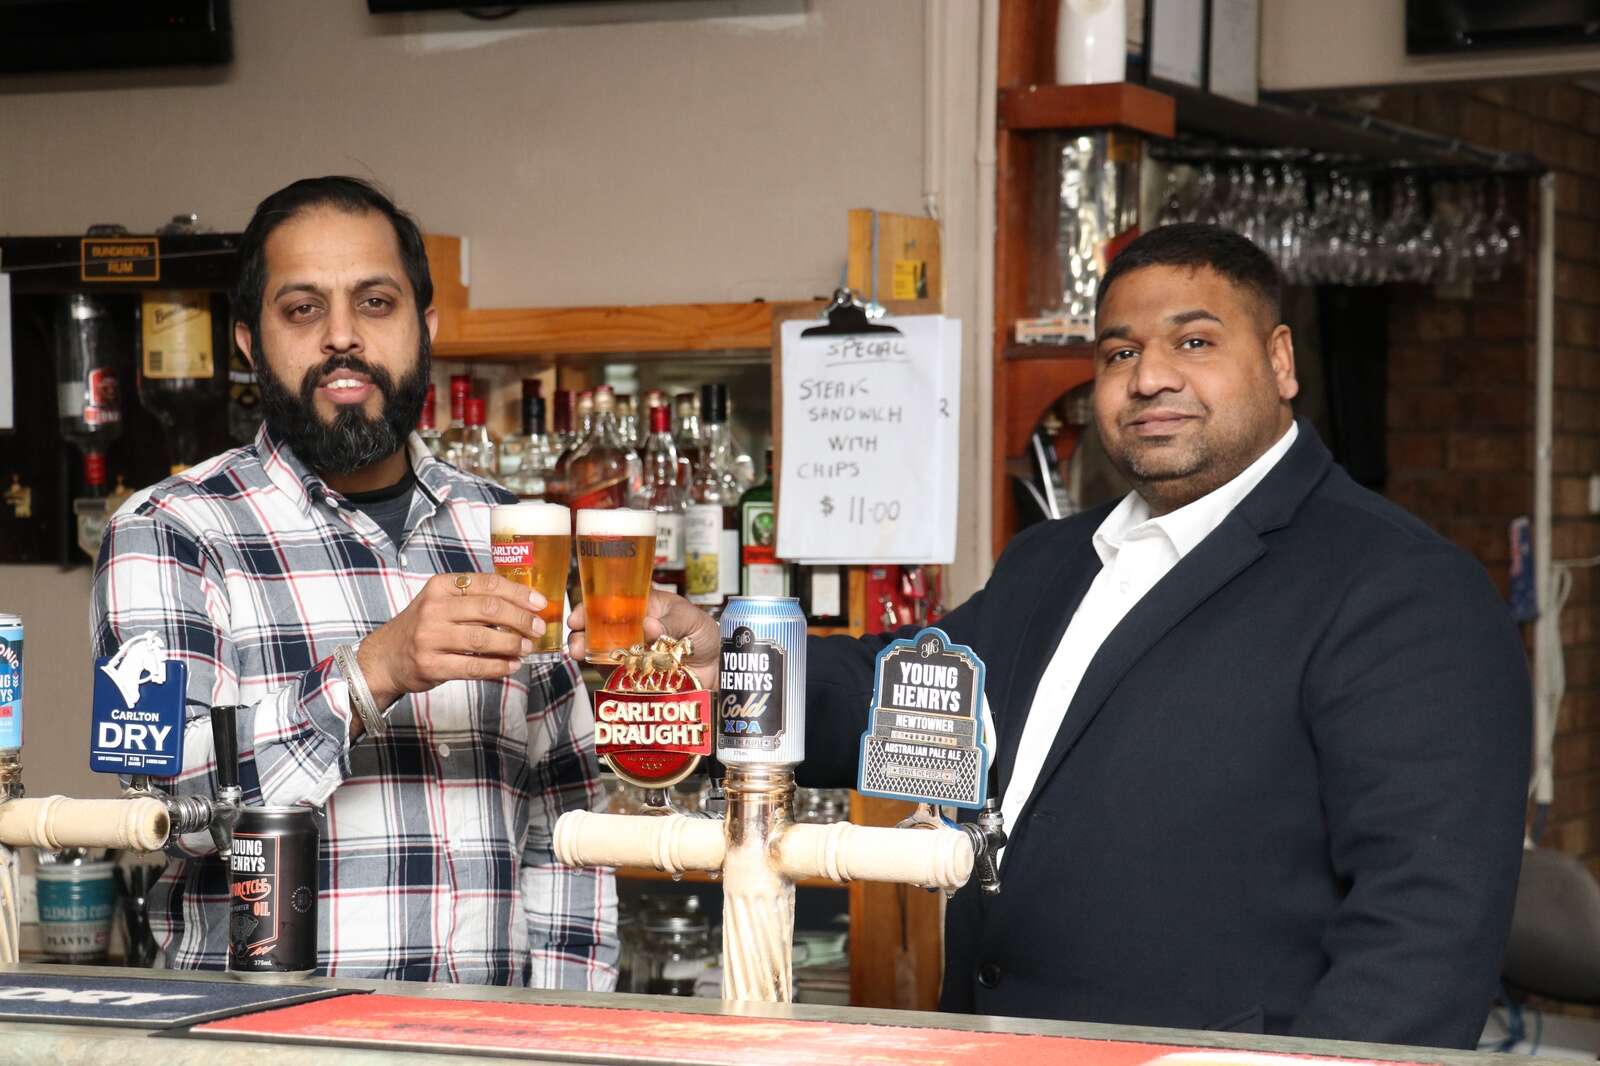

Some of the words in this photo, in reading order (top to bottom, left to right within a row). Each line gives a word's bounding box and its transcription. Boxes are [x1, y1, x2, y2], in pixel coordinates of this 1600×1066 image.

[108, 261, 133, 272] RUM
[800, 378, 869, 401] STEAK
[828, 436, 878, 452] WITH
[797, 462, 861, 479] CHIPS
[723, 652, 769, 672] YOUNG
[721, 671, 773, 691] HENRYS
[900, 661, 959, 688] YOUNG
[721, 692, 771, 718] Cold
[893, 684, 961, 712] HENRYS
[111, 709, 160, 722] CARLTON
[598, 700, 698, 722] CARLTON
[595, 721, 704, 745] DRAUGHT
[725, 720, 762, 734] XPA
[895, 714, 954, 733] NEWTOWNER
[98, 722, 172, 751] DRY
[884, 743, 927, 756] AUSTRALIAN
[928, 748, 946, 759] PALE
[947, 750, 962, 760] ALE
[253, 901, 271, 917] OIL
